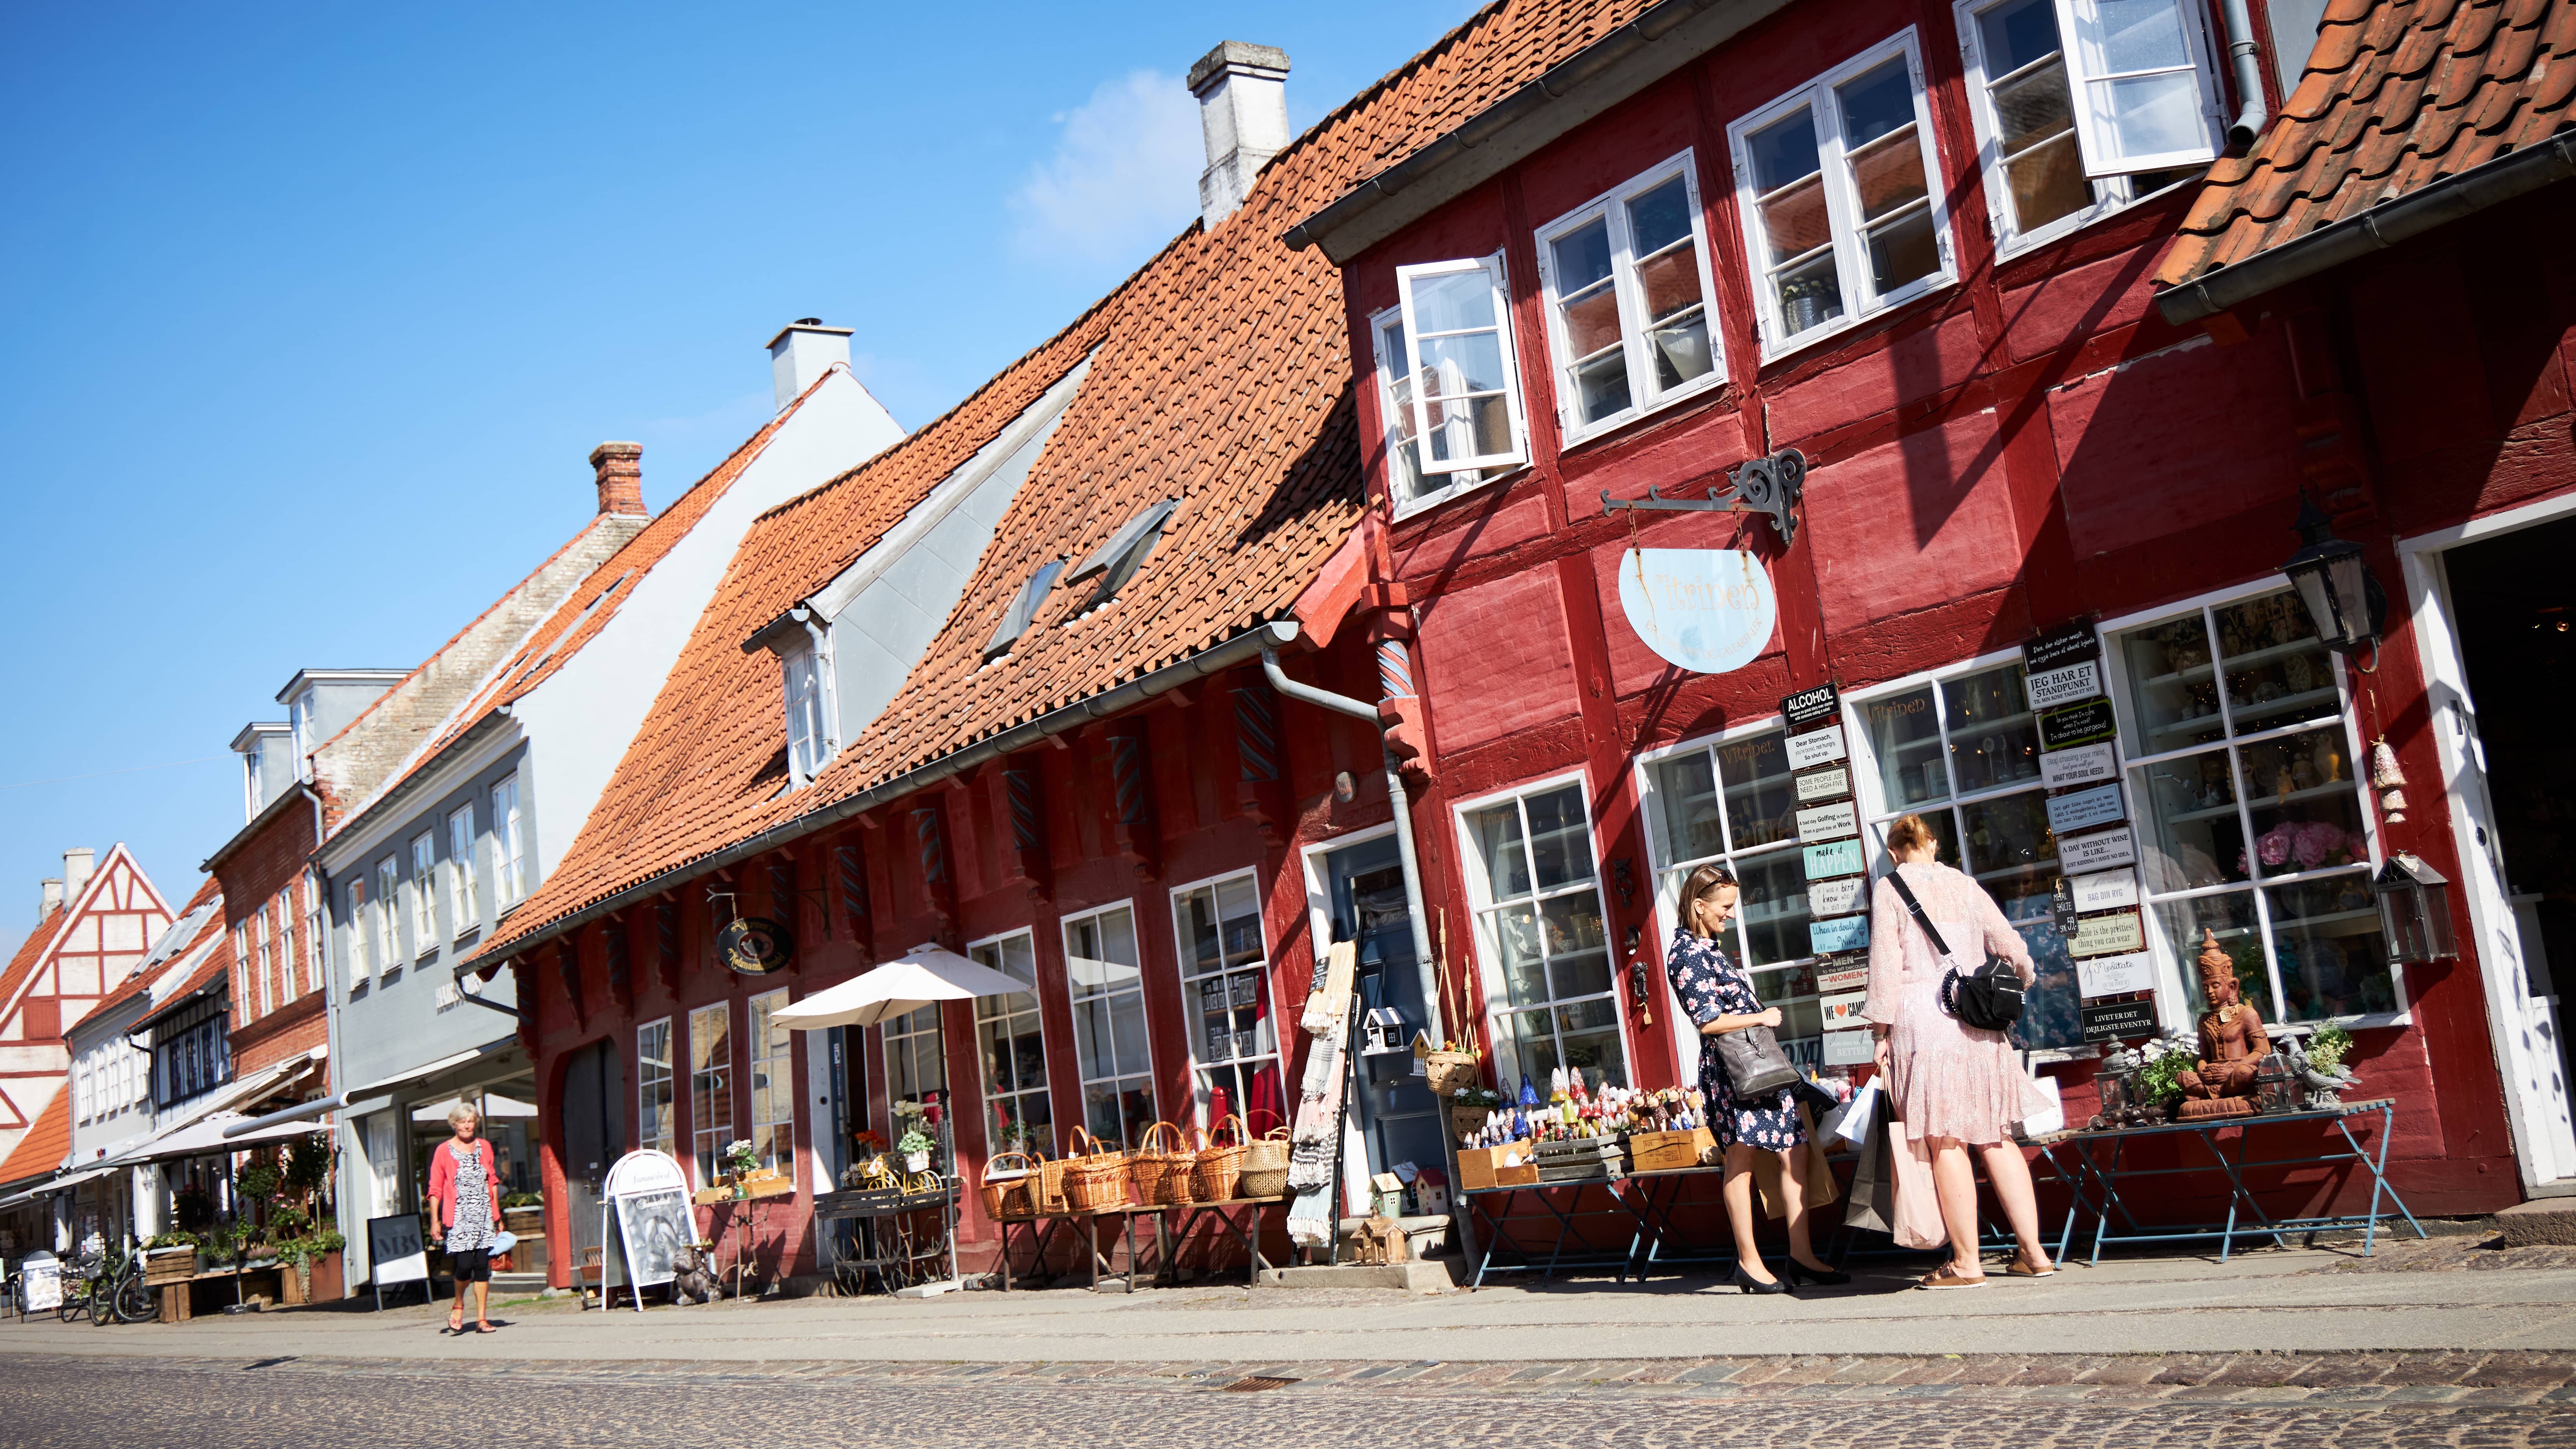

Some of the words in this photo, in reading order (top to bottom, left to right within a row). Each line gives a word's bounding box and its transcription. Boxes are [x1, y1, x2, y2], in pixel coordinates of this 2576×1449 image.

[1635, 574, 1760, 610] Vitrinen
[1703, 648, 1718, 660] OG
[2030, 676, 2049, 692] JEG
[2051, 670, 2076, 684] HAR
[2077, 665, 2092, 678] ET
[2036, 677, 2090, 698] STANDPUNKT
[1788, 688, 1833, 712] ALCOHOL
[1866, 698, 1925, 724] Vitrinen
[2084, 721, 2106, 734] gorgeous!
[1808, 734, 1832, 744] Stomach,
[1723, 739, 1776, 764] Vitrinen
[2047, 758, 2058, 766] Stop
[2059, 754, 2078, 763] chasing
[2079, 751, 2091, 760] your
[2092, 748, 2105, 757] mind
[1814, 775, 1831, 783] PEOPLE
[2052, 773, 2064, 782] WHAT
[2066, 771, 2077, 780] YOUR
[2078, 769, 2089, 778] SOUL
[2090, 766, 2104, 775] NEEDS
[1819, 780, 1844, 790] HIGH-FIVE.
[2068, 844, 2080, 852] DAY
[2081, 837, 2110, 849] WITHOUT
[2112, 834, 2129, 843] WINE
[1817, 846, 1833, 857] make
[1838, 844, 1842, 854] it
[2090, 847, 2110, 855] LIKE...
[1809, 848, 1857, 876] HAPPEN
[1841, 881, 1854, 892] bird
[1823, 894, 1838, 903] know
[2088, 892, 2099, 902] BAG
[2100, 890, 2110, 899] DIN
[2112, 888, 2123, 898] RYG
[1812, 924, 1830, 935] When
[1839, 921, 1855, 931] doubt
[2077, 928, 2092, 938] smile
[2093, 927, 2098, 935] is
[2099, 926, 2108, 934] the
[2110, 922, 2134, 935] prettiest
[1837, 935, 1857, 948] Wine
[2078, 939, 2093, 949] thing
[2094, 938, 2104, 948] you
[1832, 955, 1854, 967] MEN
[2094, 961, 2134, 974] Meditate
[1828, 971, 1863, 983] WOMEN
[1824, 1006, 1835, 1020] WE
[2086, 1023, 2119, 1034] DEJLIGSTE
[2120, 1019, 2152, 1029] EVENTYR
[1837, 1047, 1867, 1057] BETTER
